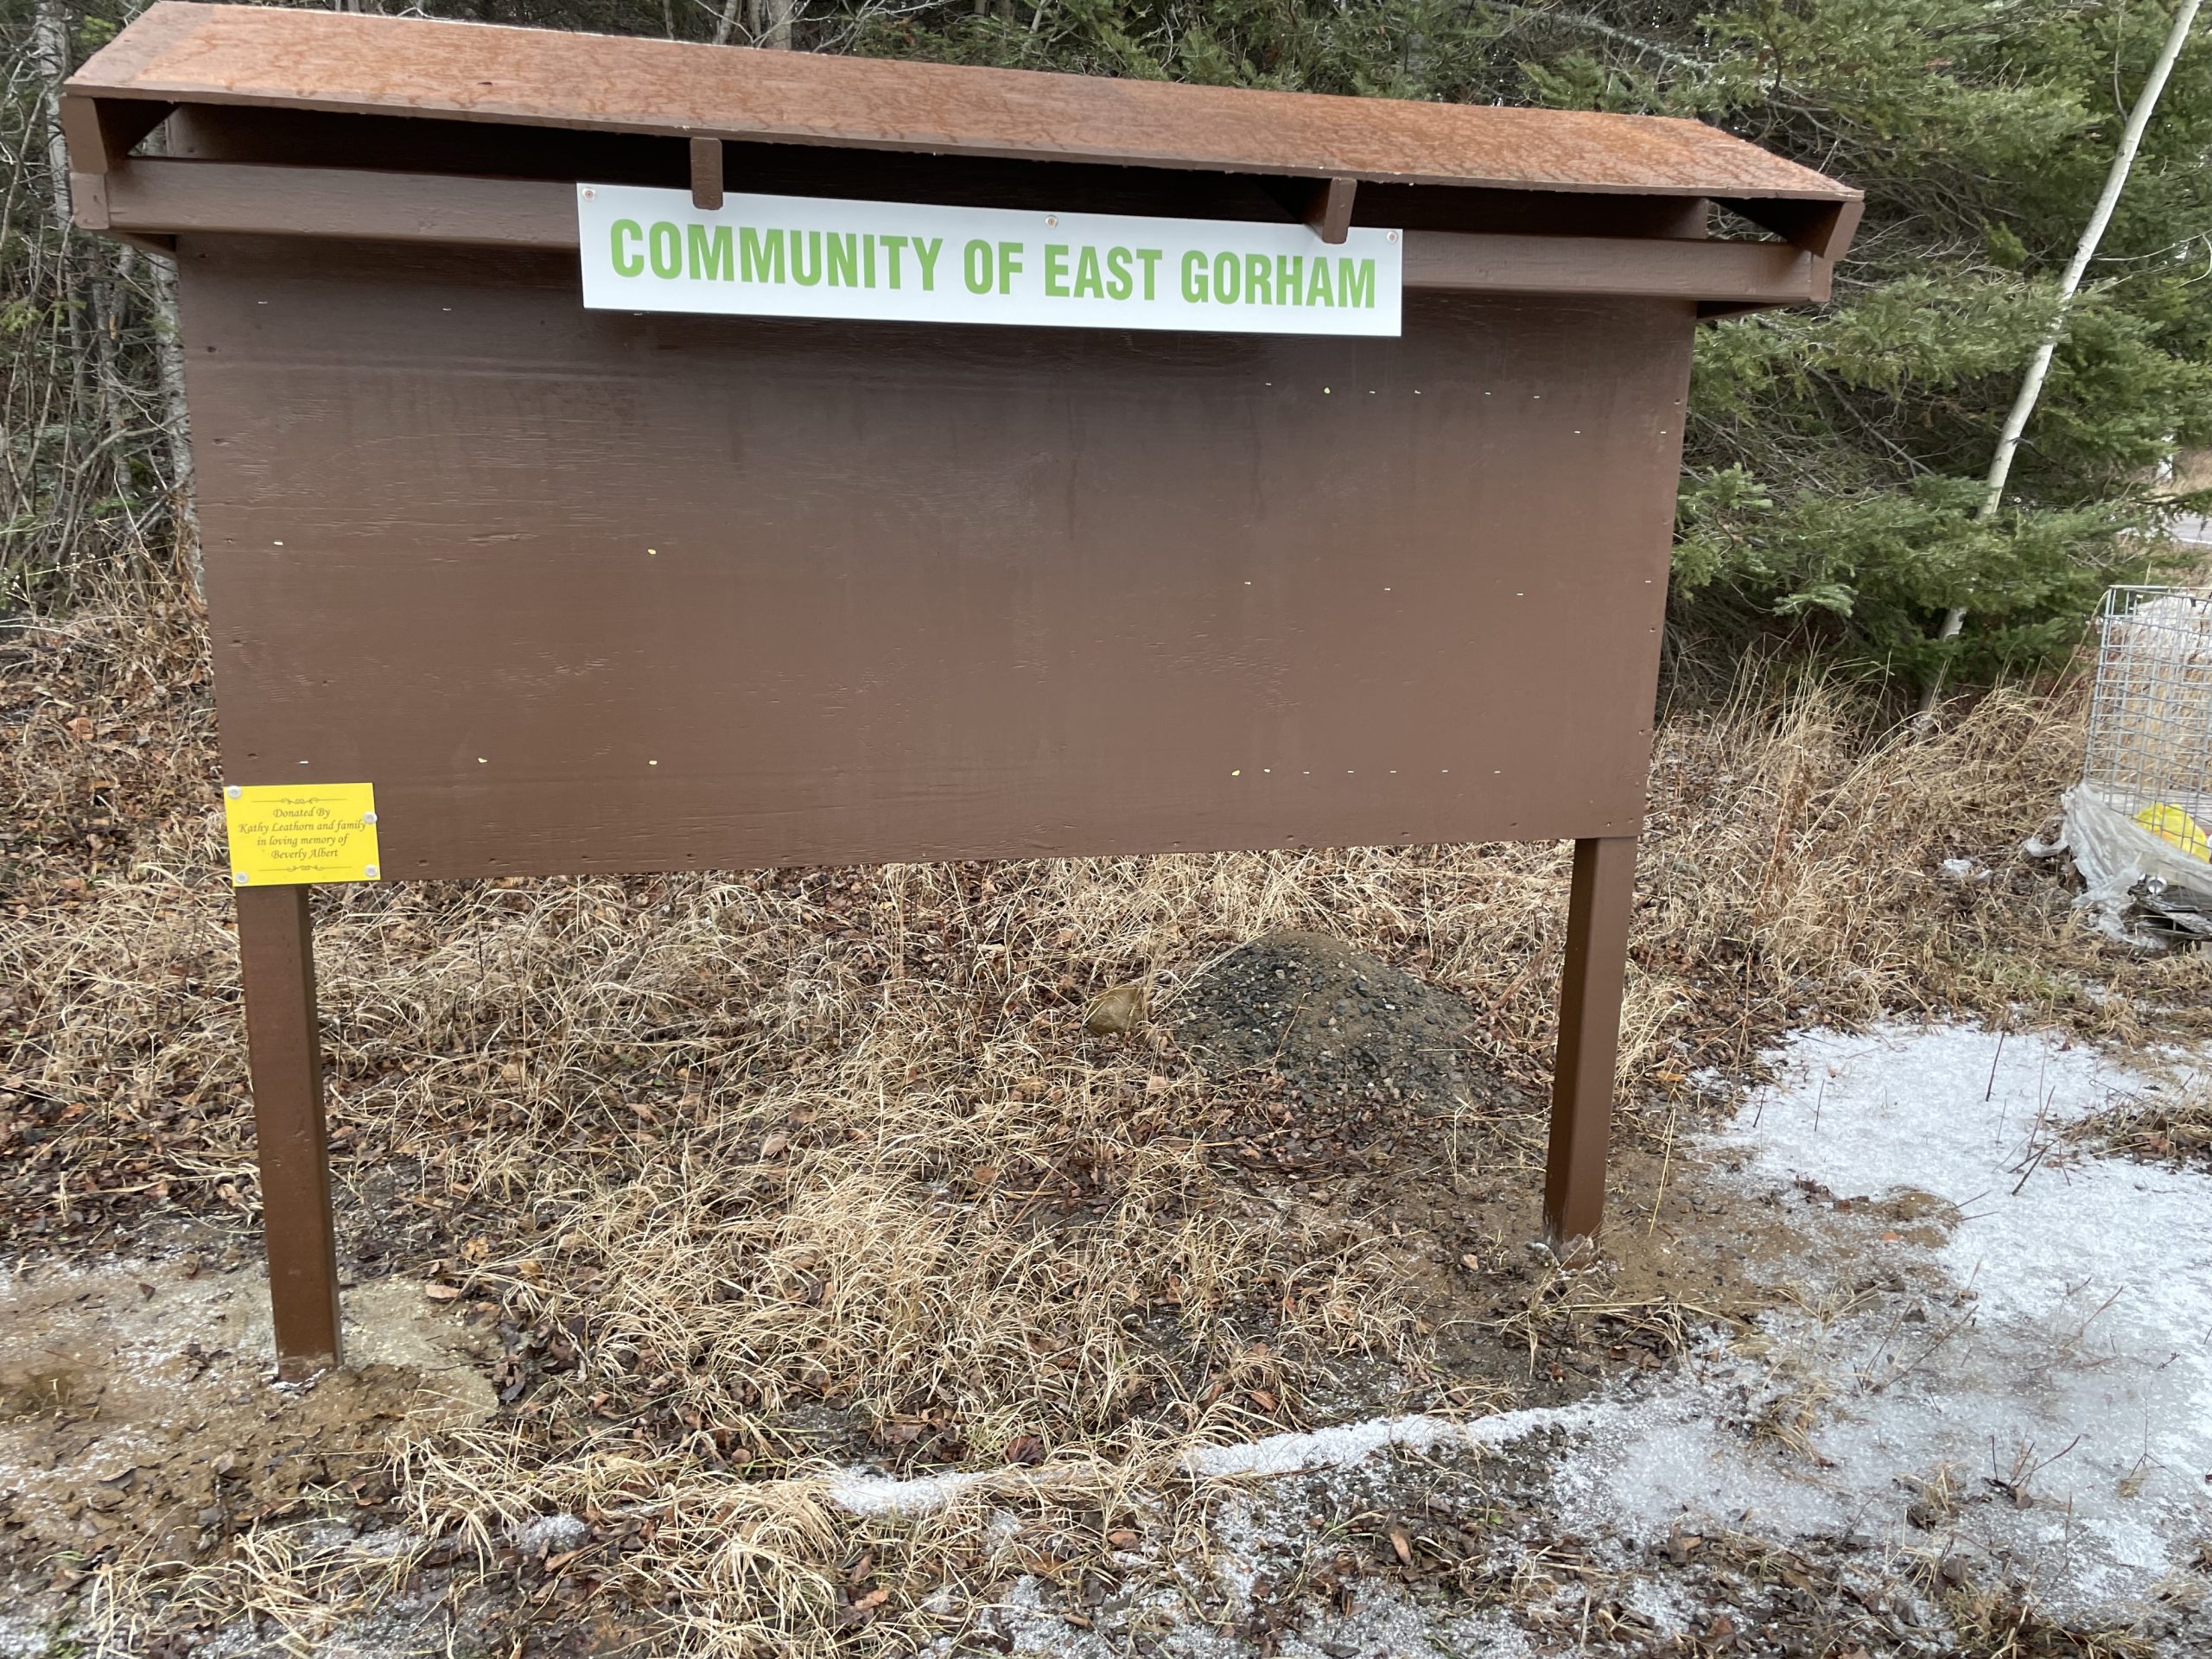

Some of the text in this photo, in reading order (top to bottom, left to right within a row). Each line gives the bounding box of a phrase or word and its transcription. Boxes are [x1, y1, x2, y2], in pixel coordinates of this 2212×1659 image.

[611, 219, 1375, 308] COMMUNITY OF EAST GORHAM
[273, 807, 330, 819] Donated By
[238, 819, 366, 835] Kathy Leathorn and family
[257, 834, 349, 848] in loving memory of
[271, 849, 339, 861] Beverly Albert
